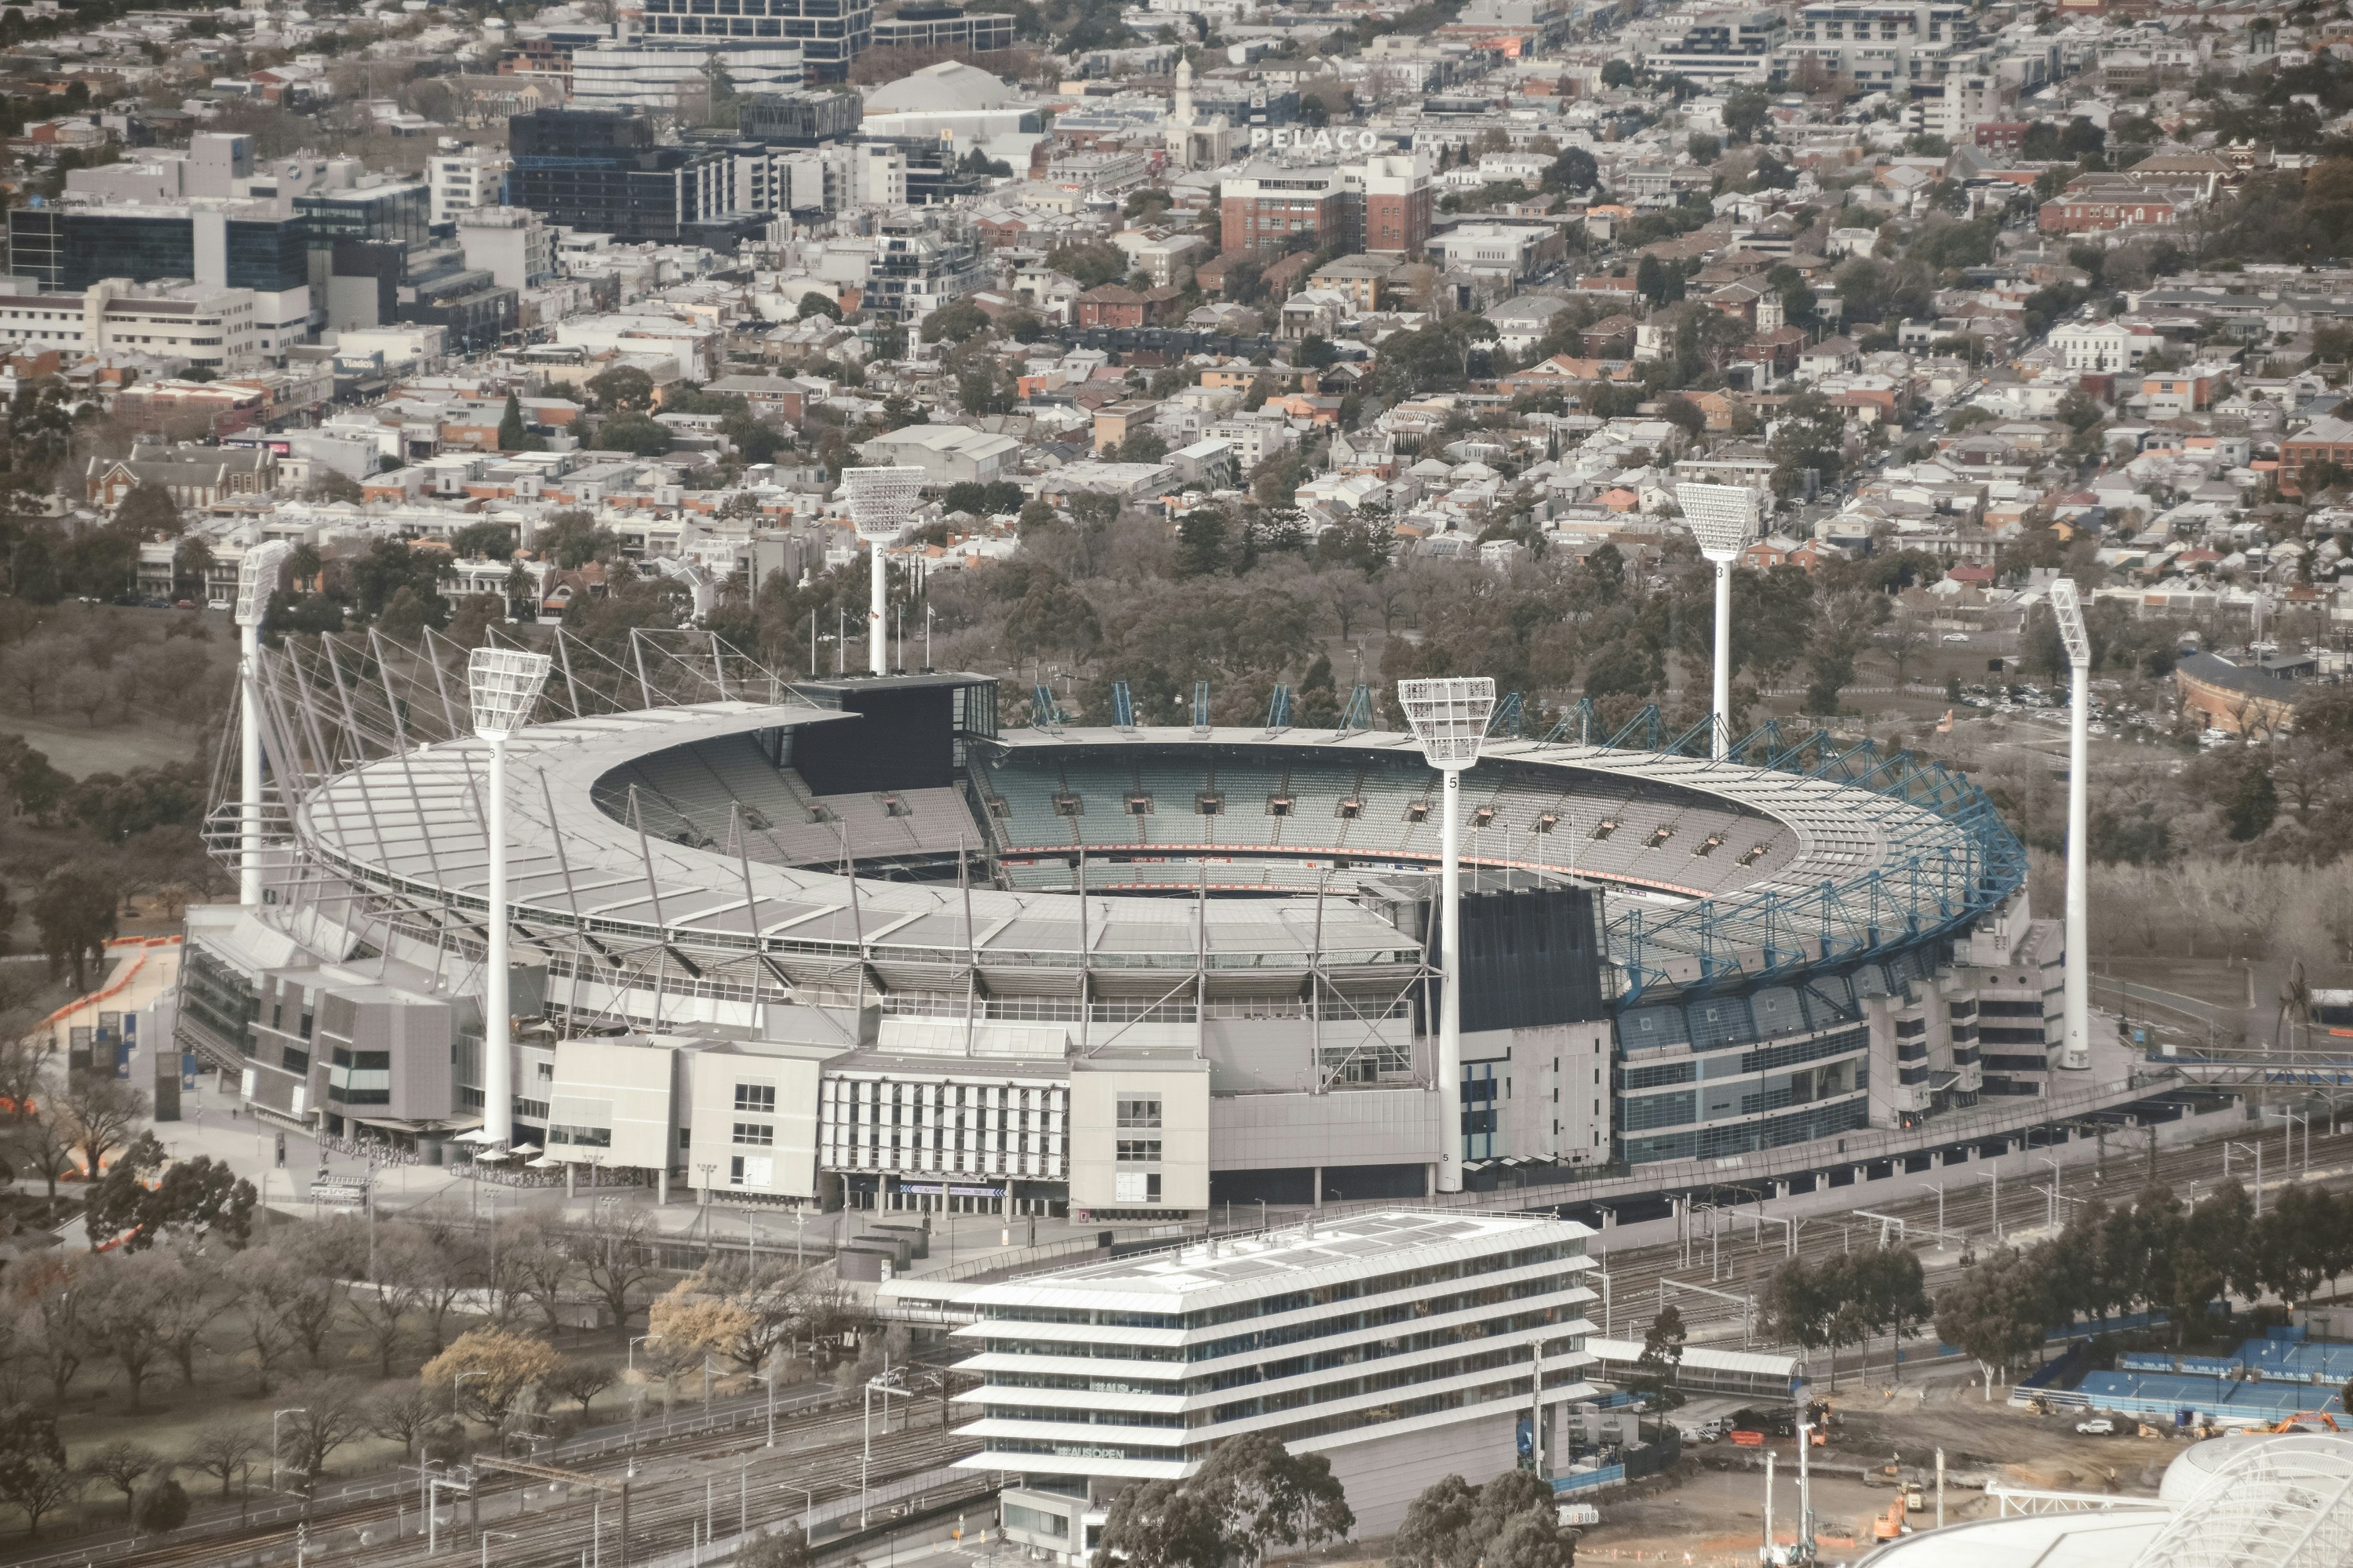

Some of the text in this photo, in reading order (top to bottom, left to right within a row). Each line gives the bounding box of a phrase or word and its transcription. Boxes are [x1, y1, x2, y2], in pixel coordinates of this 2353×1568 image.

[1251, 128, 1376, 149] PELACO
[341, 358, 375, 368] Vlado's
[877, 548, 883, 557] 2
[1717, 566, 1723, 577] 3
[490, 748, 495, 759] 6
[1449, 777, 1457, 788] 5
[1058, 1447, 1124, 1459] #AUSOPEN
